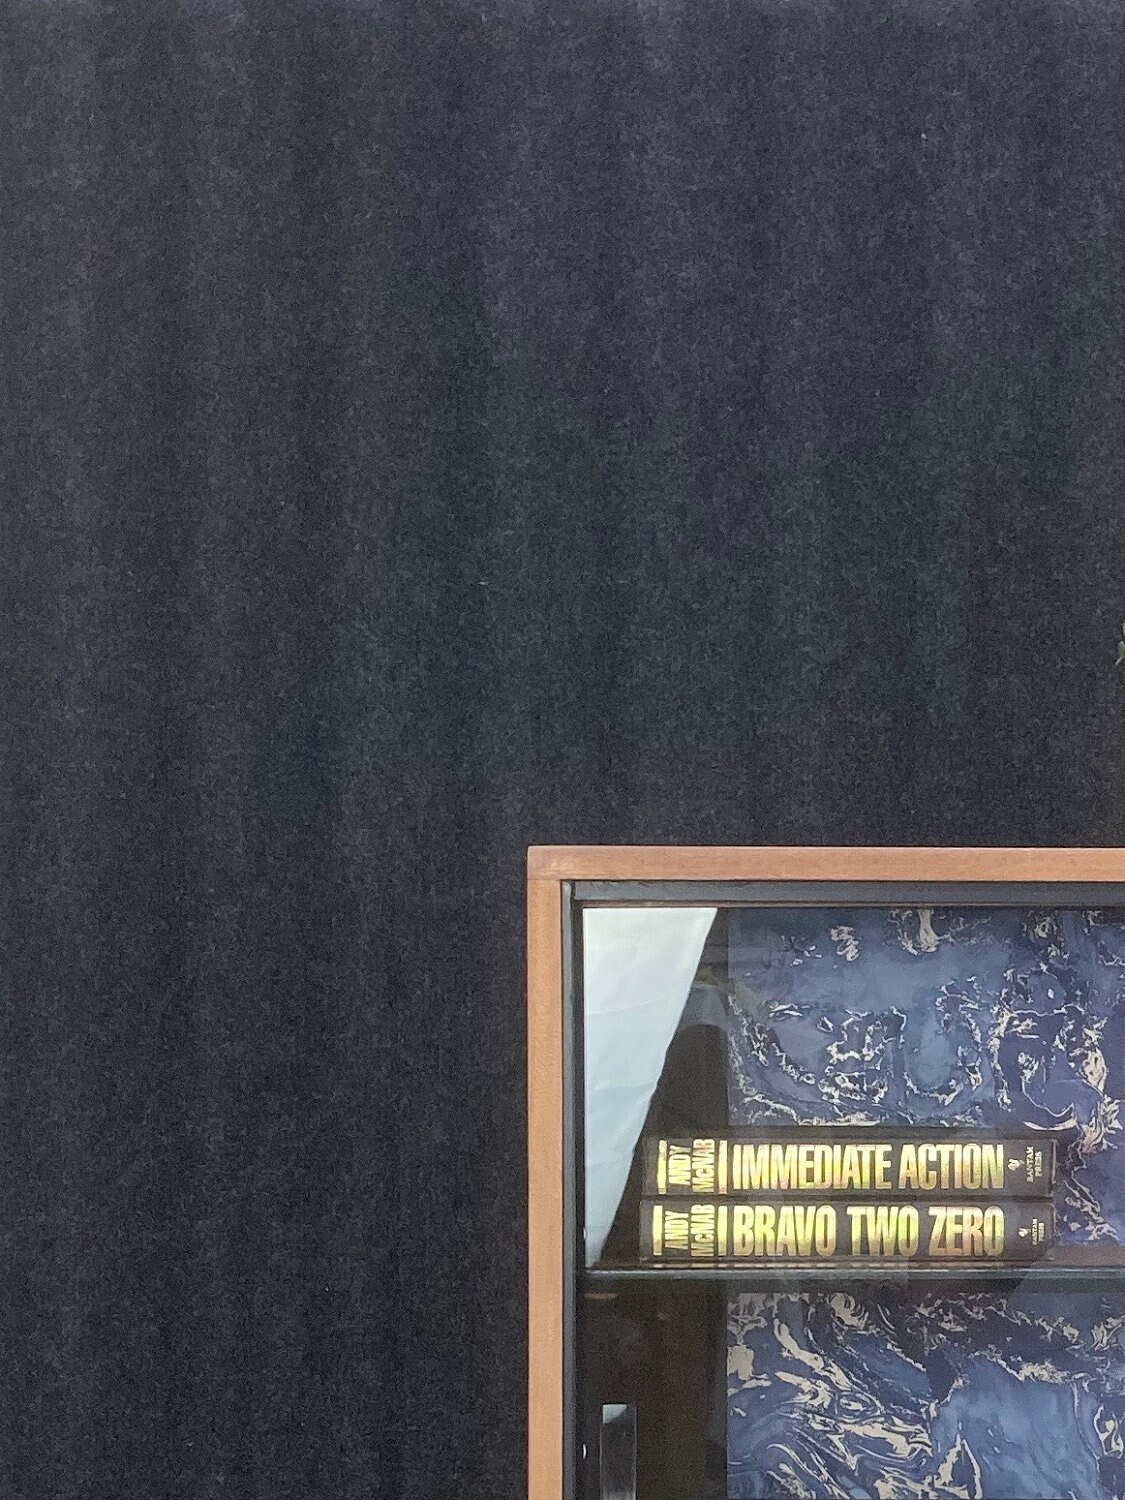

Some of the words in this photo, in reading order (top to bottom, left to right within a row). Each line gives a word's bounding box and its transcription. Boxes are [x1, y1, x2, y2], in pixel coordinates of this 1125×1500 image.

[668, 1145, 692, 1186] ANDY
[732, 1143, 892, 1190] IMMEDIATE
[898, 1143, 1004, 1190] ACTION
[664, 1210, 689, 1250] ANDY
[732, 1204, 837, 1257] BRAVO
[846, 1204, 920, 1257] TWO
[928, 1204, 1005, 1257] ZERO
